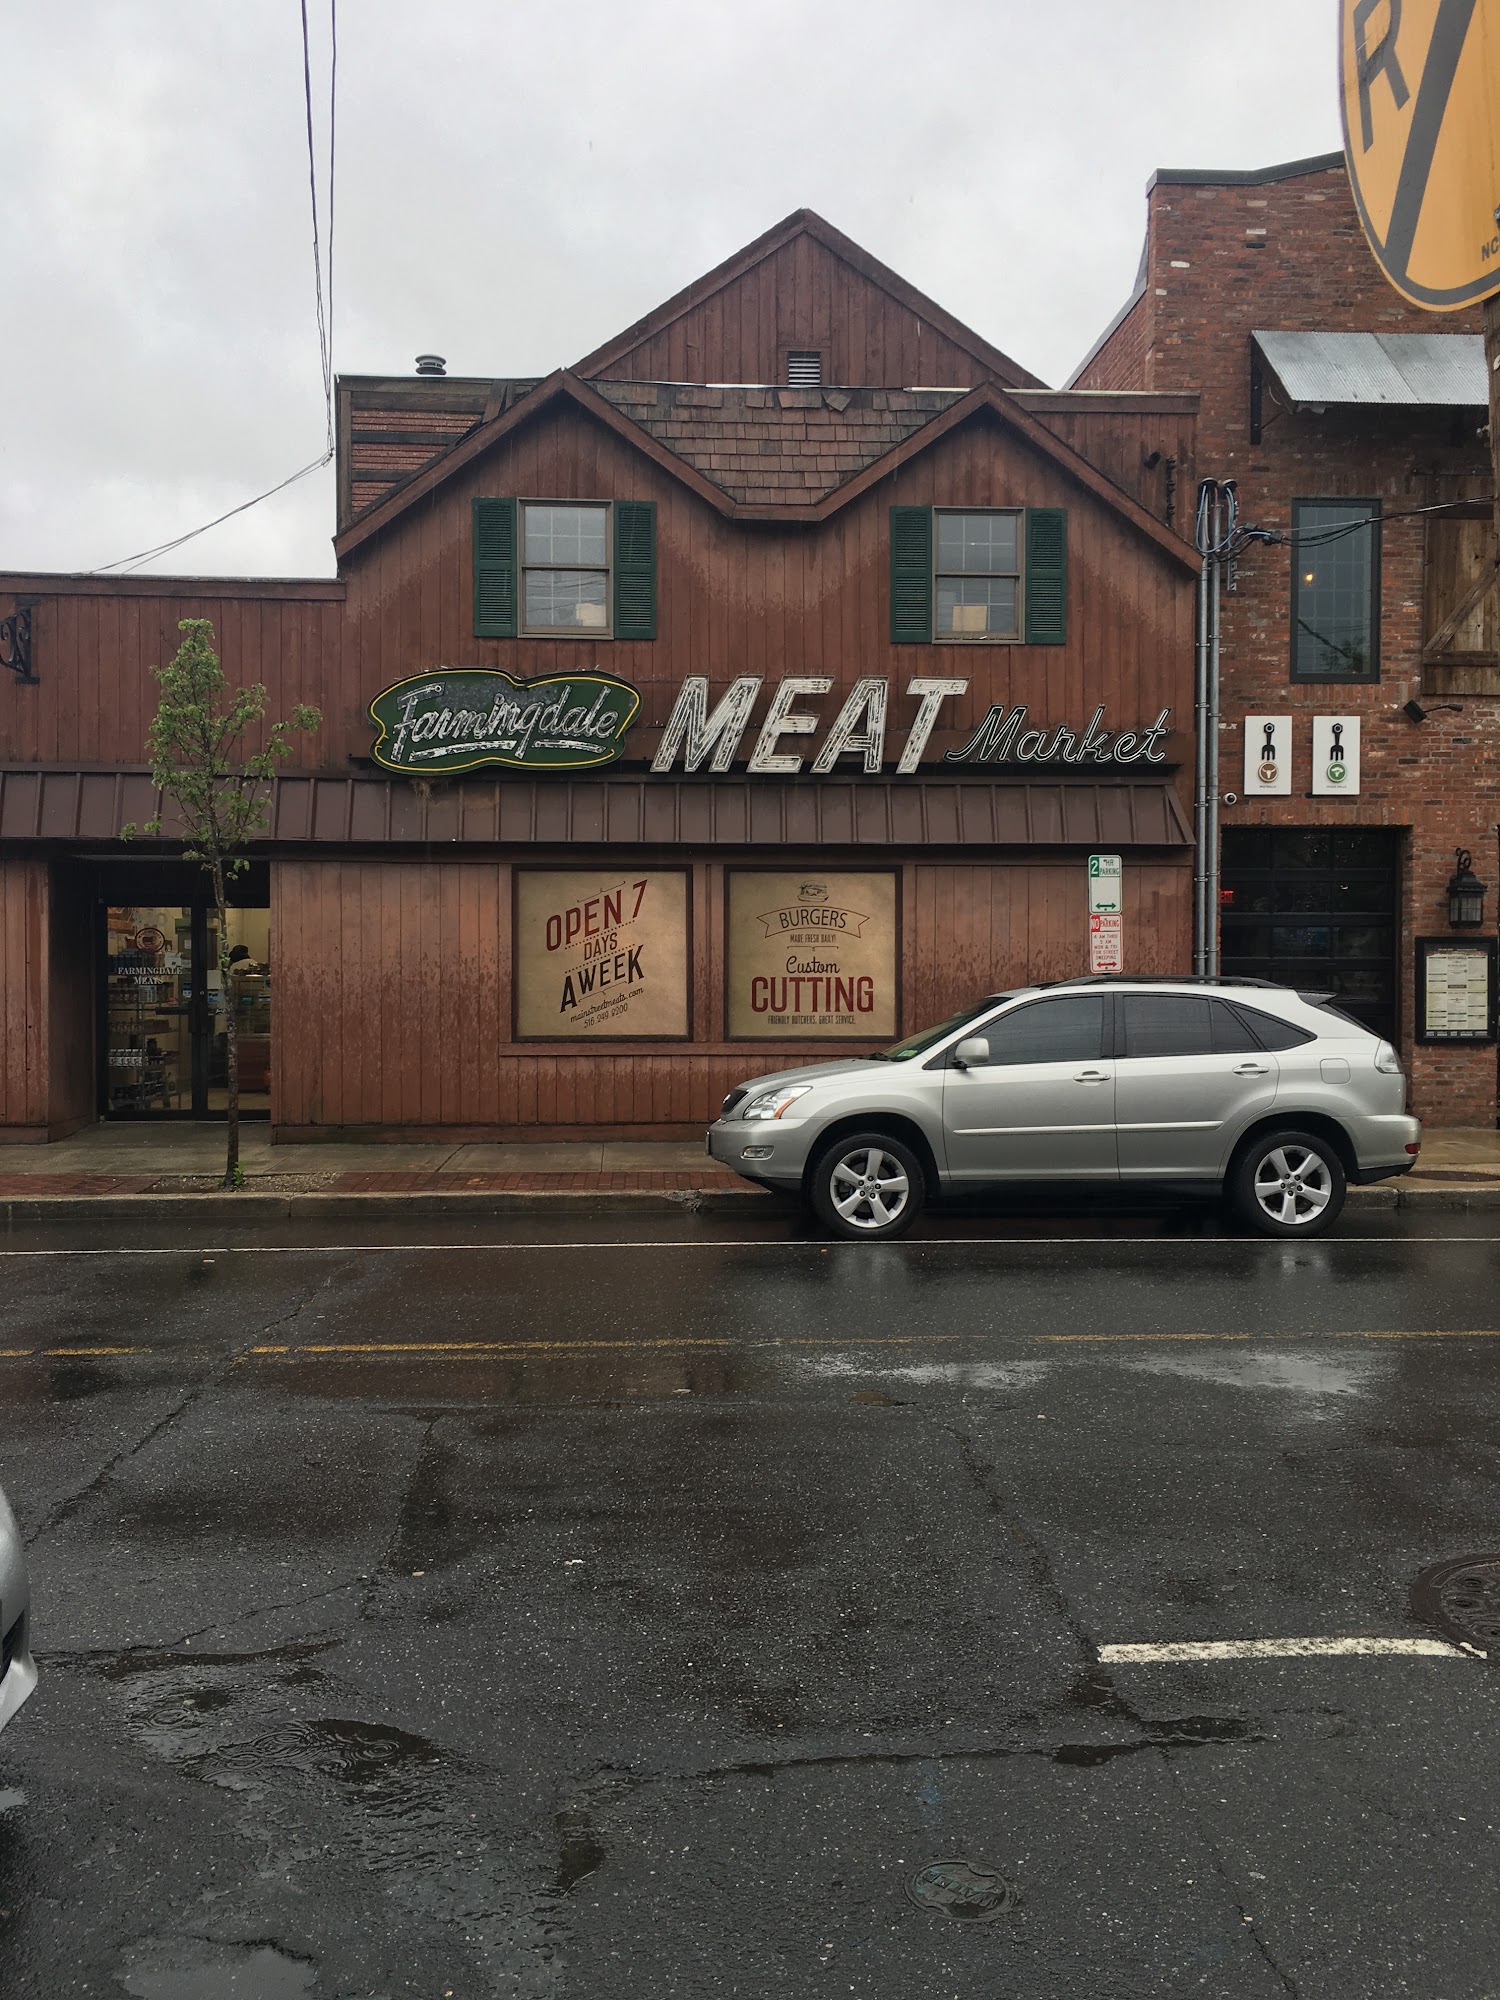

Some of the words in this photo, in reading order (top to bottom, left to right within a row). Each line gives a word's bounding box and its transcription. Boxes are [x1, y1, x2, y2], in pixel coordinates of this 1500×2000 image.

[391, 681, 620, 764] Farmingdale
[650, 674, 969, 775] MEAT
[946, 704, 1171, 765] Market
[1091, 859, 1098, 875] 2
[546, 889, 622, 952] OPEN
[632, 879, 648, 919] 7
[778, 908, 848, 929] BURGERS
[1091, 917, 1100, 930] NO
[1100, 919, 1119, 927] PARKING
[584, 932, 618, 961] DAYS
[790, 934, 804, 943] MADE
[804, 934, 820, 943] FRESH
[821, 934, 836, 943] DAILY!
[118, 967, 183, 975] FARMINGDALE
[786, 955, 841, 974] Custom
[134, 976, 164, 985] MEATS
[559, 975, 577, 1014] A
[577, 944, 645, 995] WEEK
[570, 987, 645, 1023] mainstreetmeats.com
[751, 976, 874, 1013] CUTTING
[767, 1015, 790, 1025] FRIENDLY
[791, 1015, 818, 1025] BUTCHERS.
[818, 1015, 834, 1025] GREAT
[835, 1015, 857, 1025] SERVICE.
